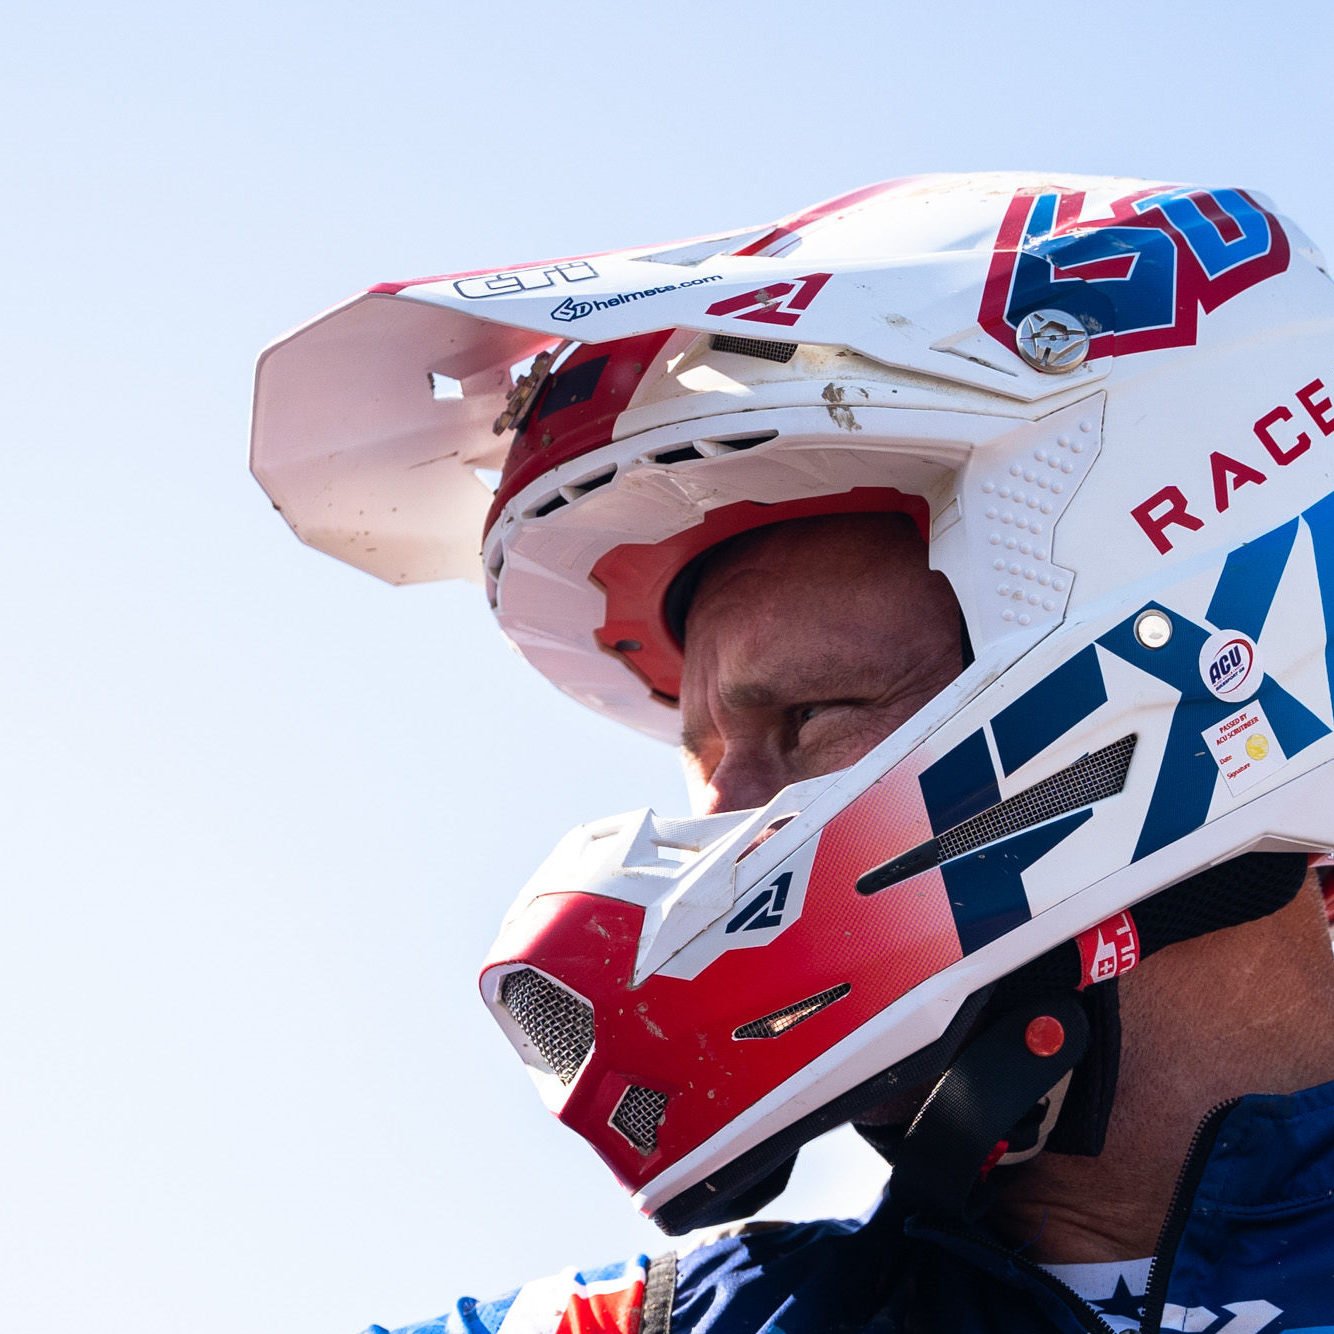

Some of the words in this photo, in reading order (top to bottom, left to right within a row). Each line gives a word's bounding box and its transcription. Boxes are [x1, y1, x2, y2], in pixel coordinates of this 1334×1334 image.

[1209, 645, 1242, 685] ACU
[1216, 735, 1228, 746] ACU
[1227, 716, 1259, 738] SCRUTINEER
[1219, 717, 1240, 734] PASSED
[1239, 713, 1247, 723] BY
[1219, 755, 1232, 765] Date
[1227, 763, 1250, 779] Signature
[1116, 912, 1135, 976] ULL
